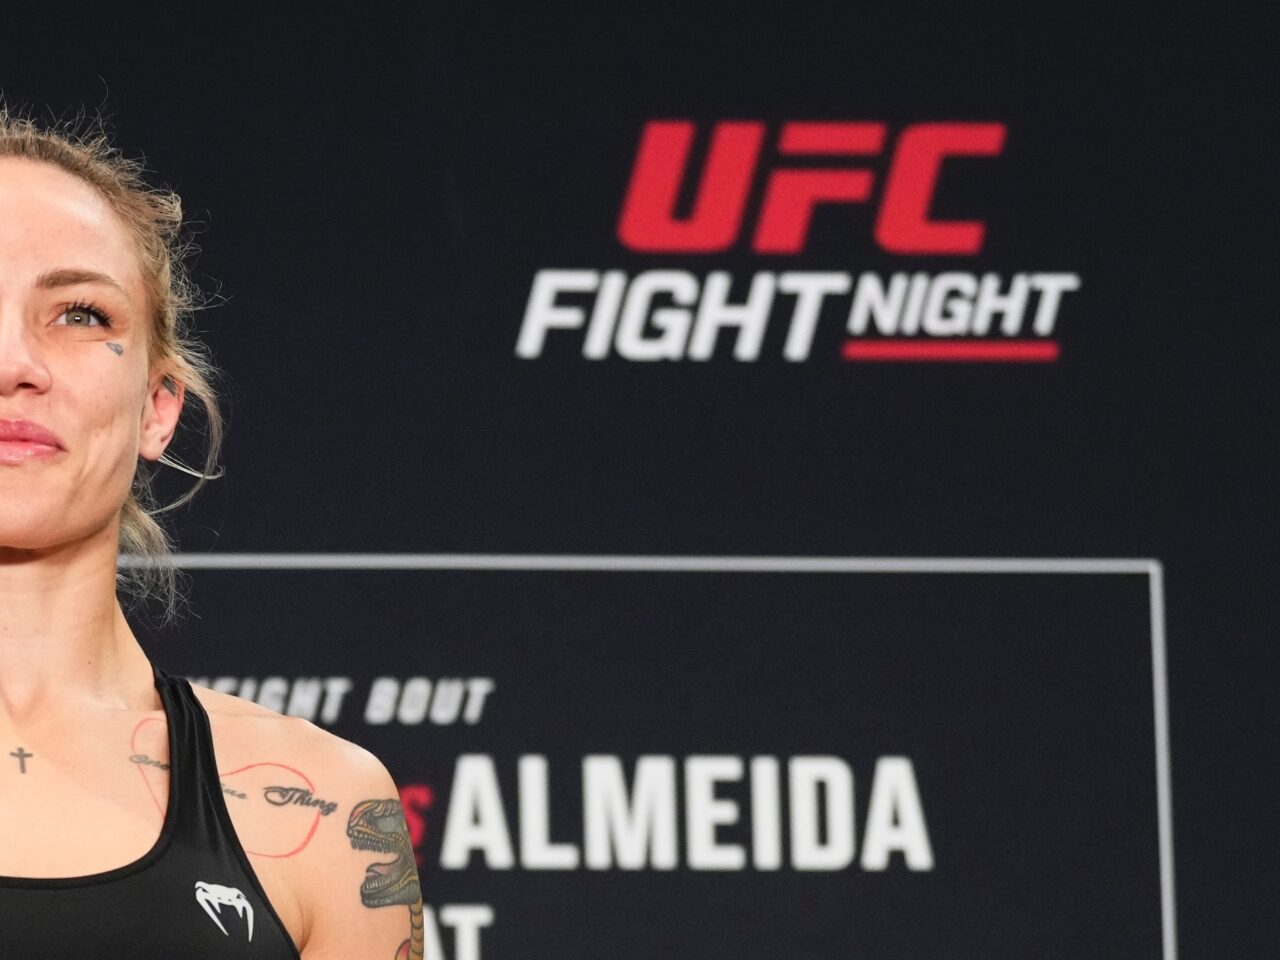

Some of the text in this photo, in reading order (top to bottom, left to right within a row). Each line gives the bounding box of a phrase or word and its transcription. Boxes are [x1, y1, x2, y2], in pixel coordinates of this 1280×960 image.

[616, 121, 1007, 255] UFC
[516, 270, 1081, 362] FIGHT NIGHT
[365, 677, 495, 726] BOUT
[440, 754, 935, 871] ALMEIDA
